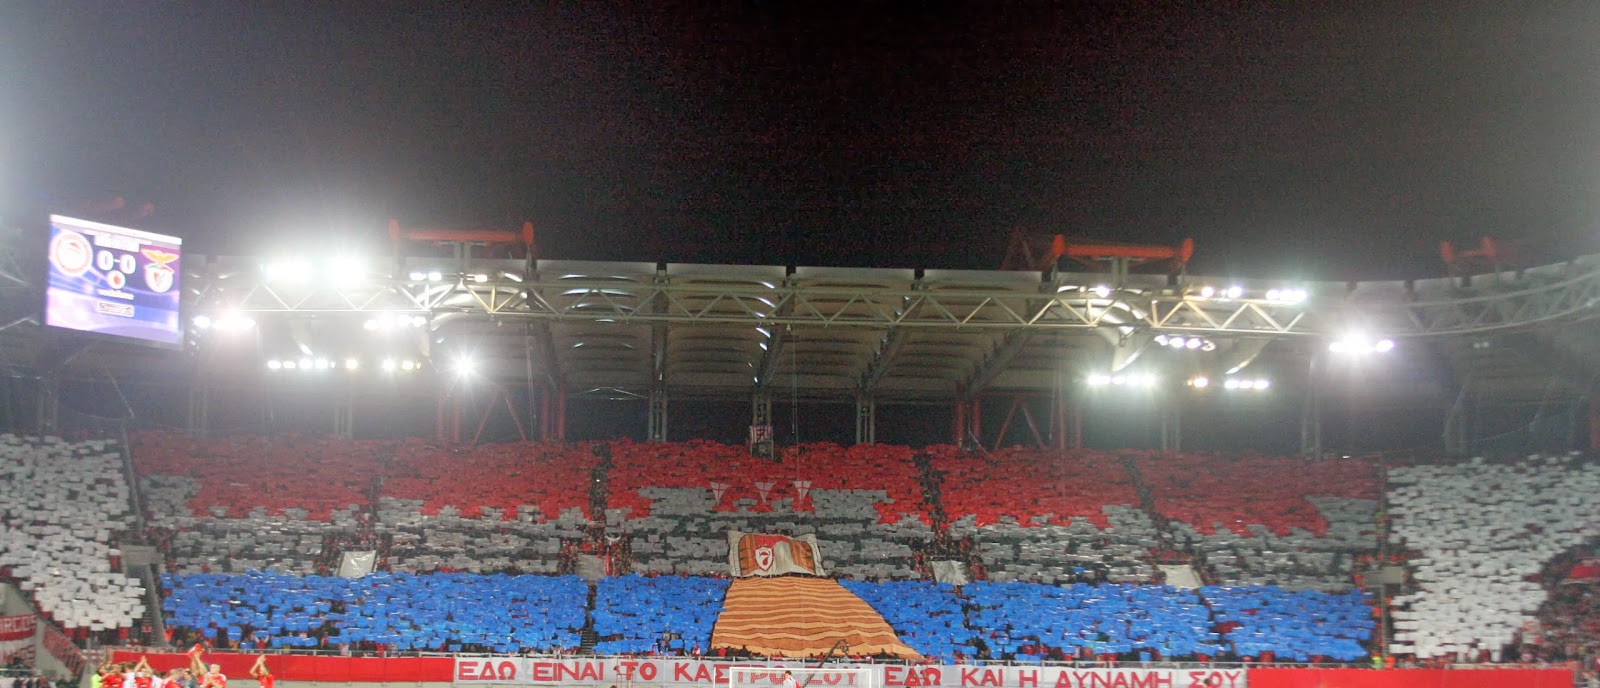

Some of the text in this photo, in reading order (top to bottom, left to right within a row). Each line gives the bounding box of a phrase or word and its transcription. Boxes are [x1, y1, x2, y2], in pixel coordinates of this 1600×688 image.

[458, 660, 517, 680] ΕΔΩ
[533, 661, 605, 681] ΕΙΝΑΙ
[620, 661, 658, 680] ΤΟ
[884, 666, 941, 686] ΕΔΩ
[961, 667, 1004, 686] ΚΑΙ
[1019, 669, 1038, 687] Η
[1055, 670, 1173, 688] ΔΥΝΑΜΗ
